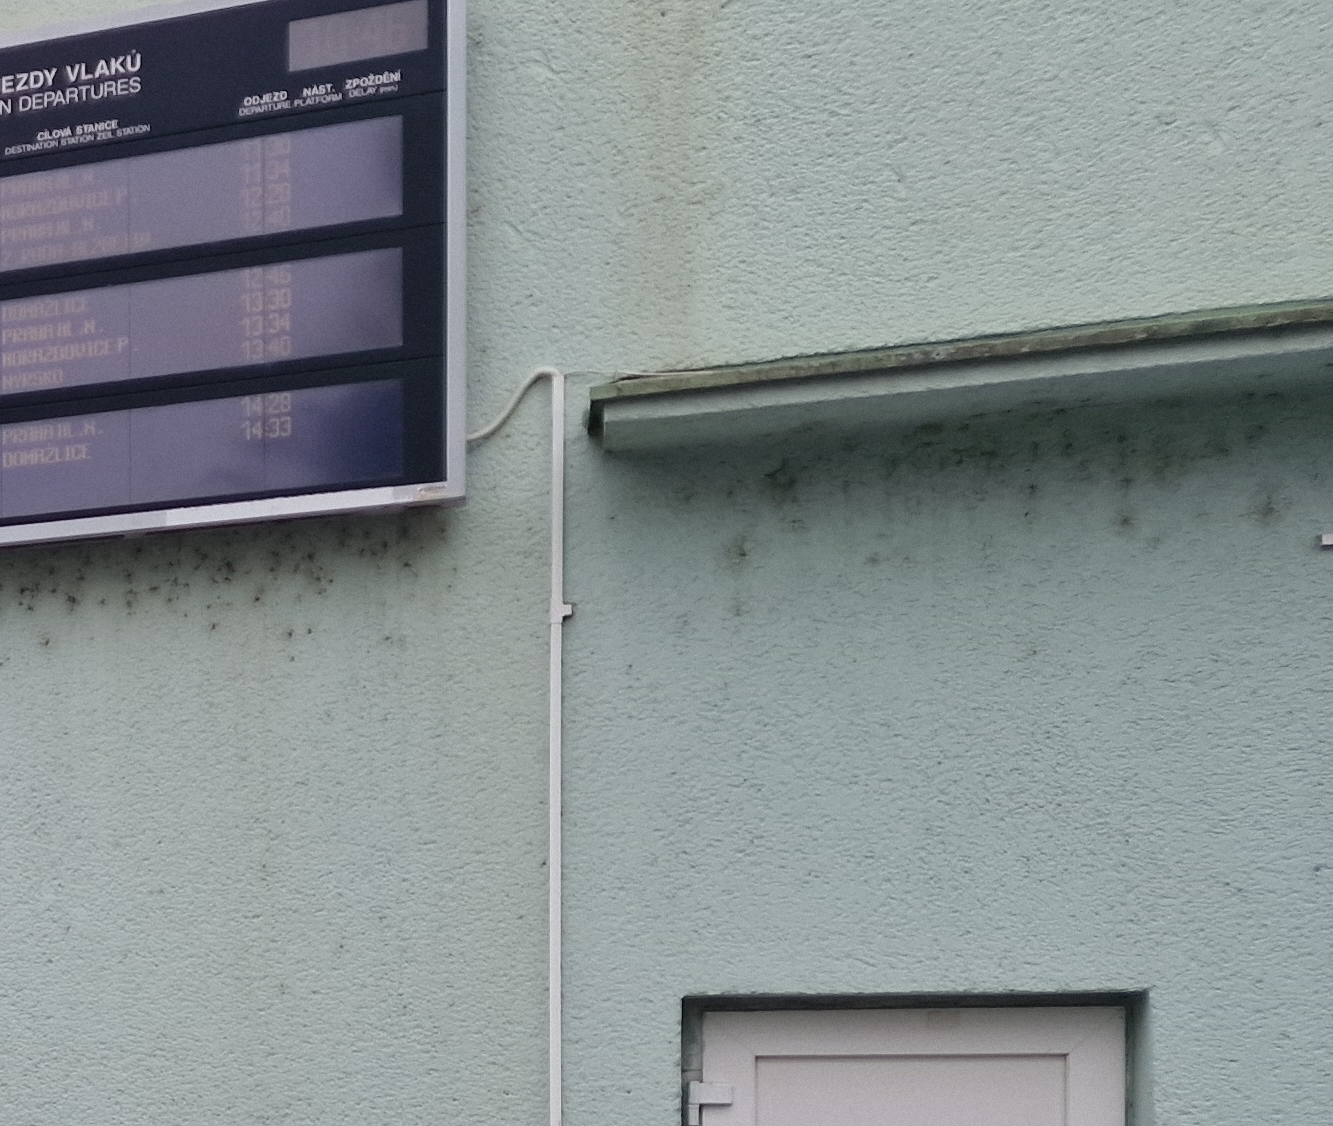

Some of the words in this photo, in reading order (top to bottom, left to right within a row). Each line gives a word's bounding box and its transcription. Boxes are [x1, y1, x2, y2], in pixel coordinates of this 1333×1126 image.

[67, 49, 142, 82] VLAKŮ
[19, 76, 141, 112] DEPARTURES
[239, 101, 291, 116] DEPARTURE
[294, 94, 342, 107] PLATFORM
[349, 86, 378, 98] DELAY
[244, 90, 288, 106] ODJEZD
[303, 83, 336, 97] NÁST.
[345, 69, 401, 89] ZPOŽDĚNÍ
[5, 140, 59, 155] DESTINATION
[61, 135, 94, 148] STATION
[116, 123, 151, 138] STATION
[37, 125, 73, 141] CÍLOVÁ
[76, 119, 119, 136] STANICE
[240, 312, 292, 337] 13:34
[240, 415, 292, 441] 14:33
